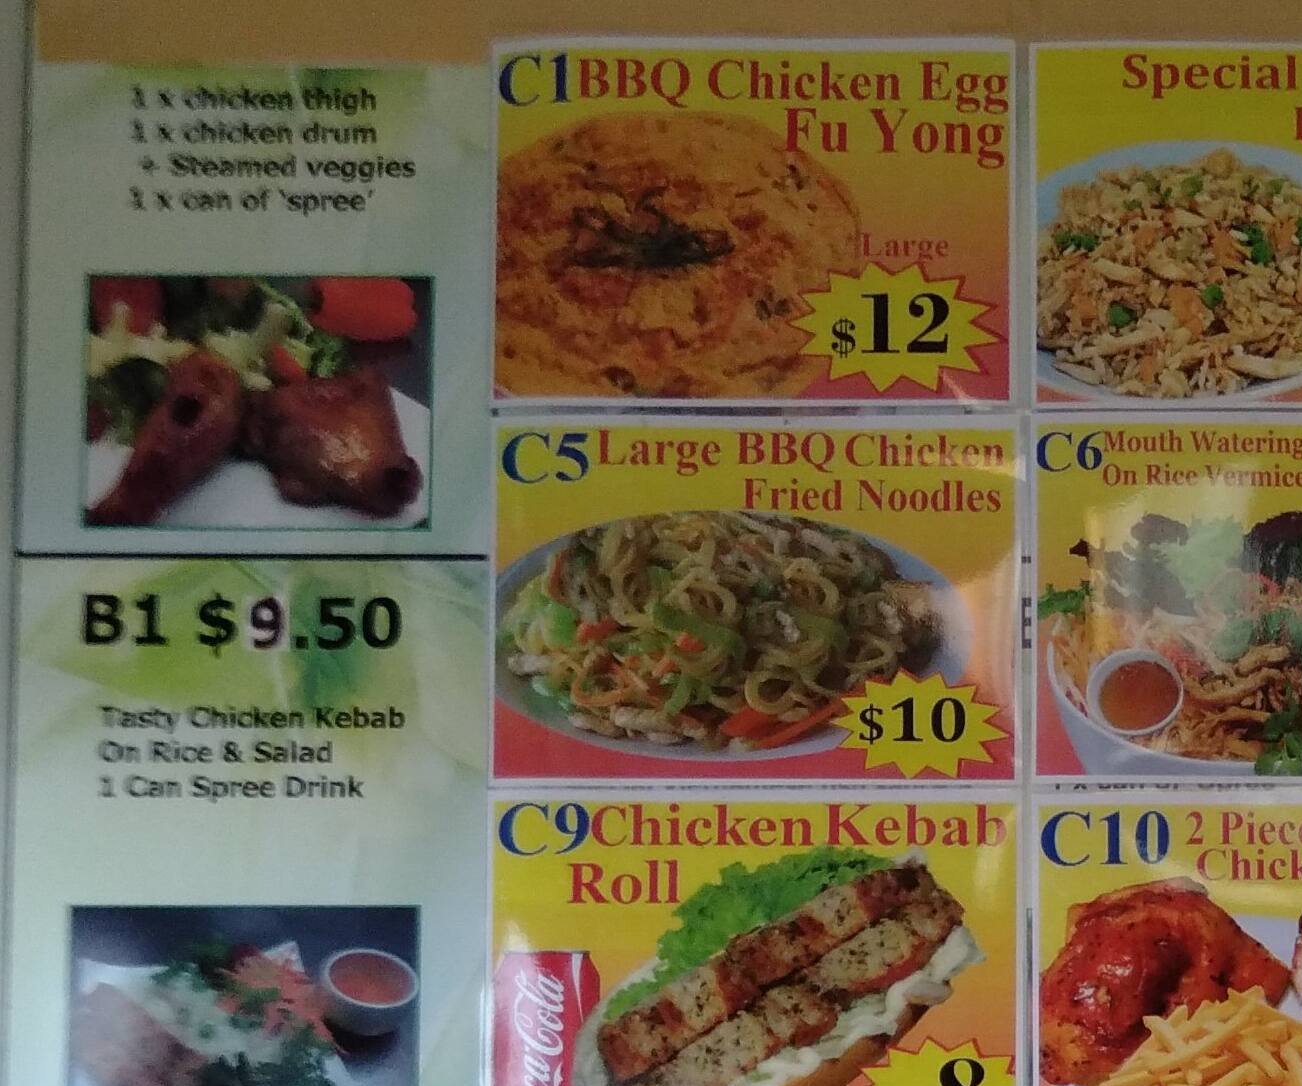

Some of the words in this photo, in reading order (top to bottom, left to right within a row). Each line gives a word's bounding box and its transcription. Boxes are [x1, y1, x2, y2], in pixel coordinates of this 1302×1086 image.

[500, 54, 568, 106] C1
[784, 108, 847, 154] Fu
[871, 108, 1006, 169] Yong
[169, 154, 296, 177] Steamed
[306, 157, 416, 182] veggies
[155, 192, 172, 211] x
[182, 194, 232, 211] can
[240, 189, 270, 211] of
[862, 233, 949, 260] Large
[831, 293, 949, 358] $12
[502, 432, 590, 484] C5
[1036, 431, 1103, 472] C6
[1104, 431, 1182, 454] Mouth
[1103, 465, 1138, 487] On
[1147, 465, 1197, 486] Rice
[743, 478, 842, 511] Fried
[857, 480, 1001, 512] Noodles
[82, 594, 168, 647] B1
[197, 594, 400, 658] $9.50
[101, 707, 179, 732] Tasty
[191, 707, 304, 729] Chicken
[316, 707, 405, 729] Kebab
[101, 777, 115, 797] 1
[125, 777, 182, 798] Can
[193, 777, 275, 803] Spree
[286, 777, 363, 798] Drink
[1185, 812, 1203, 845] 2
